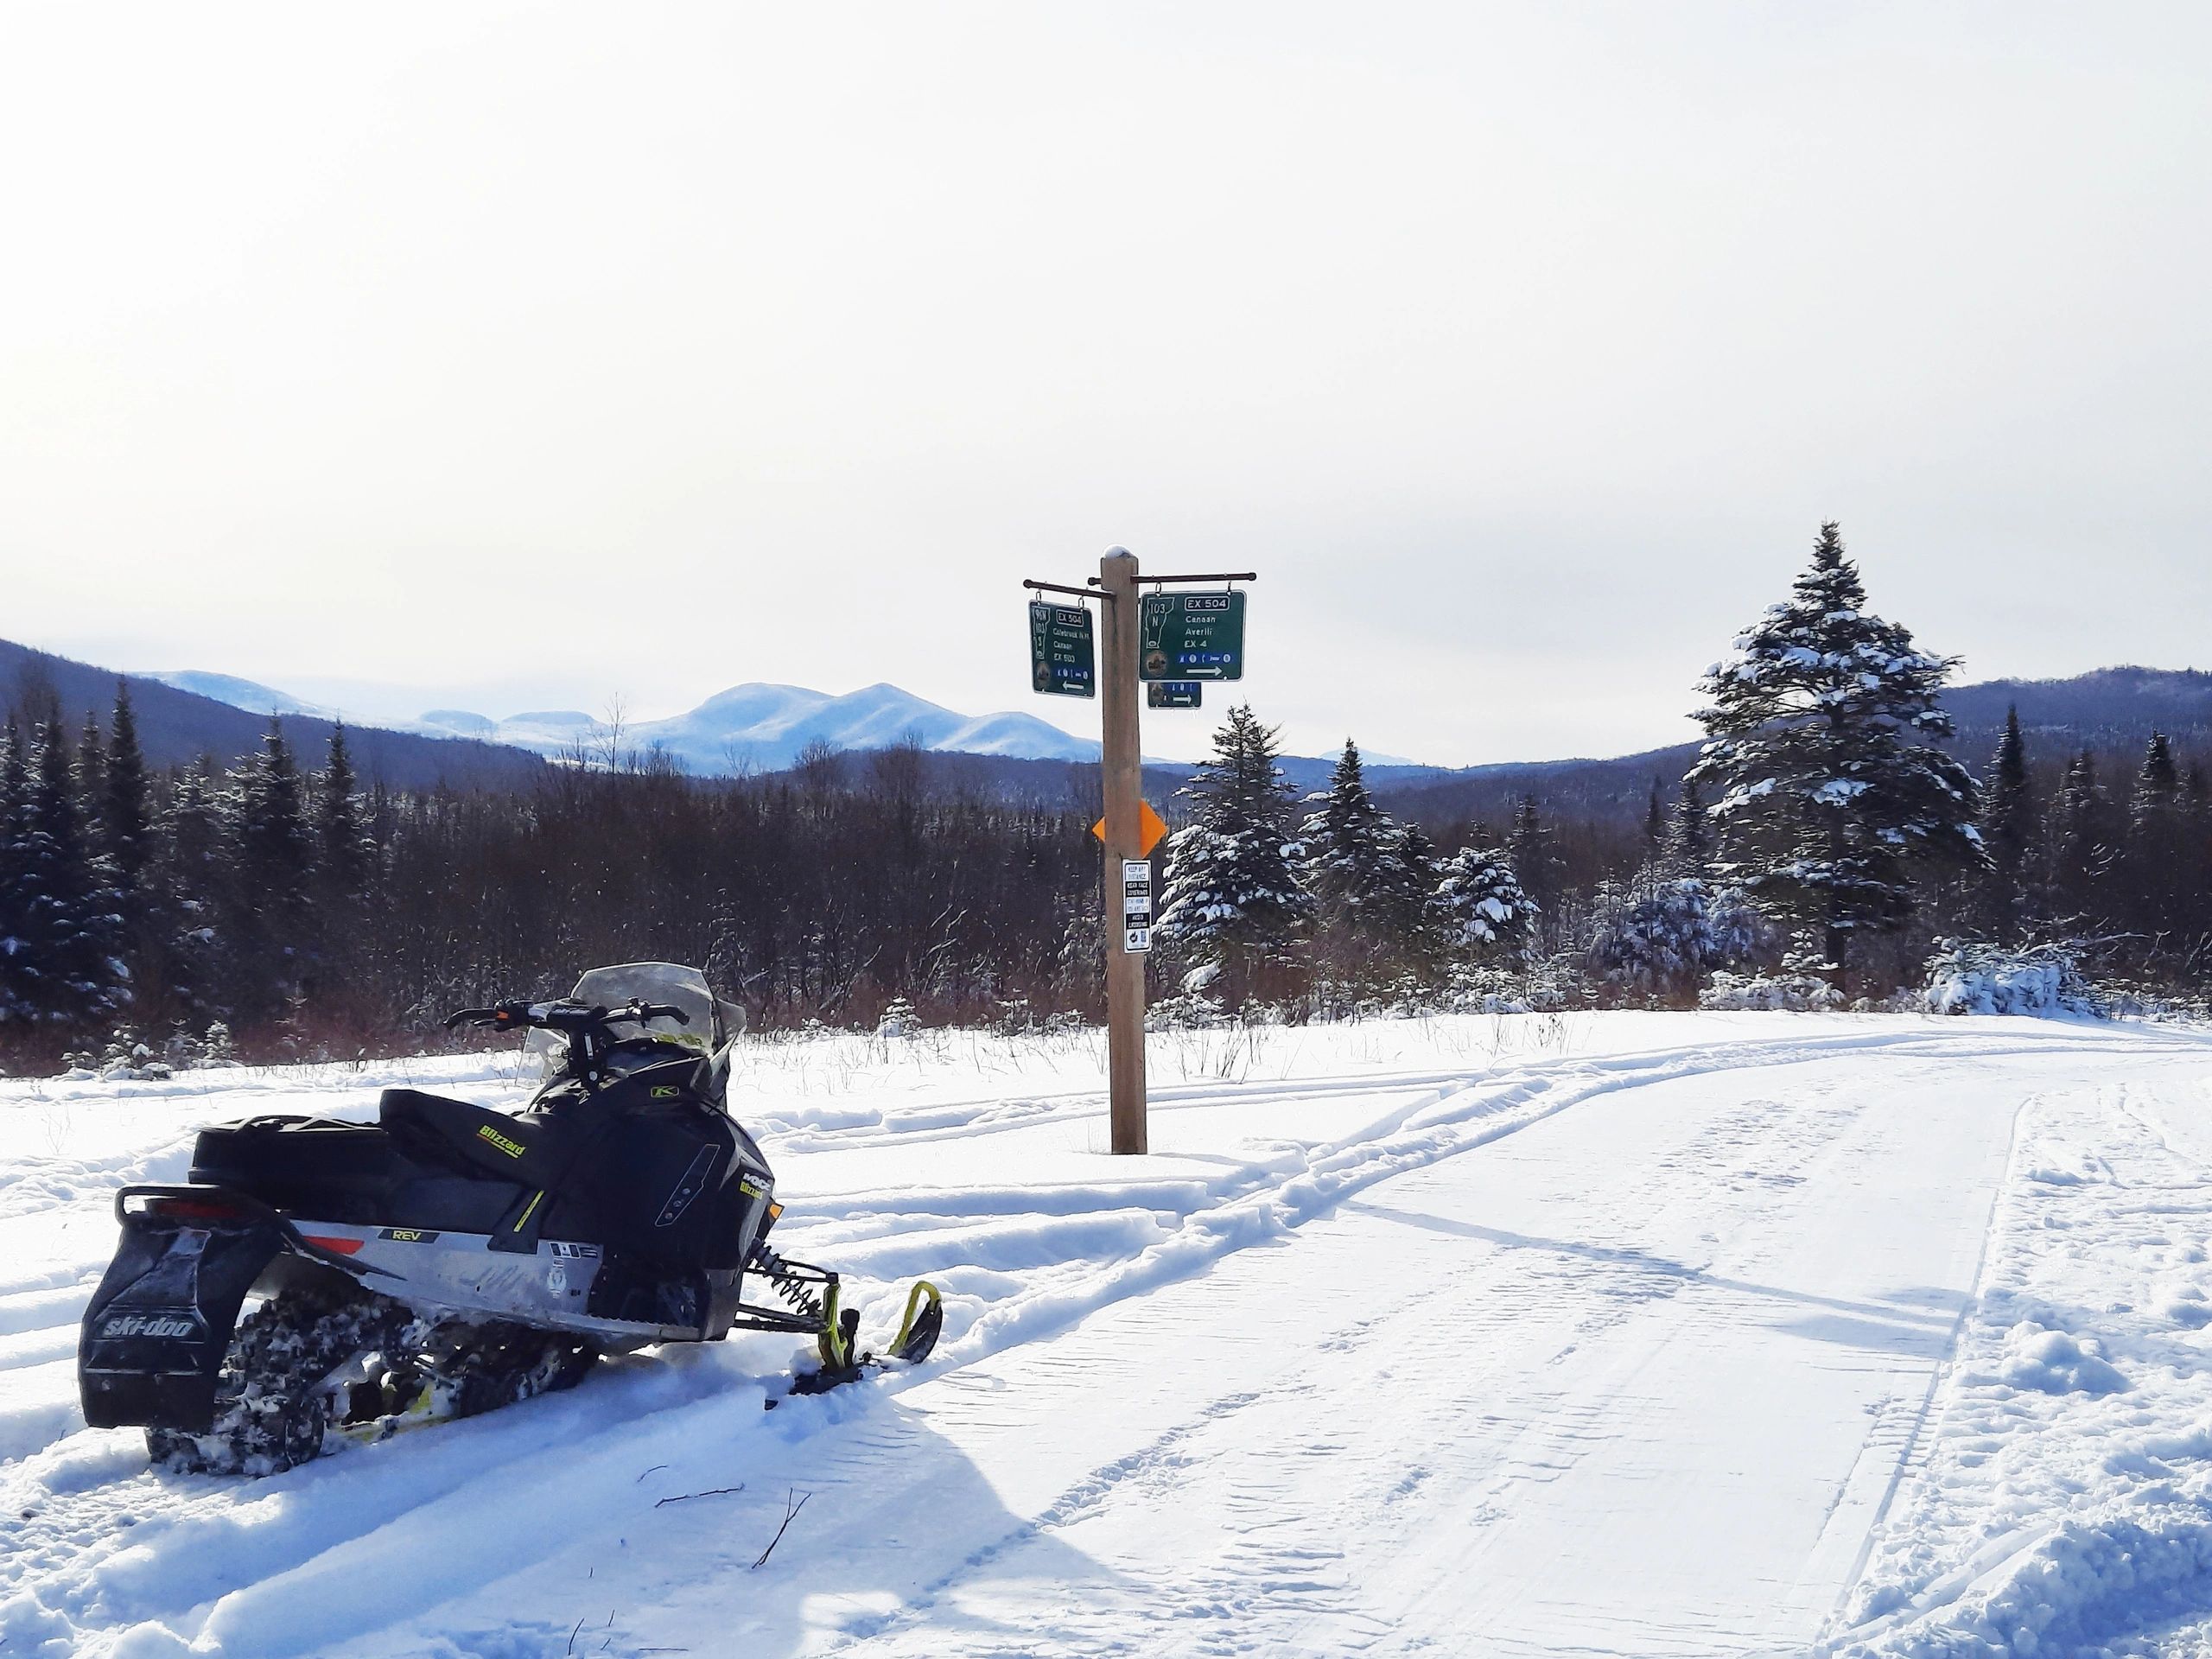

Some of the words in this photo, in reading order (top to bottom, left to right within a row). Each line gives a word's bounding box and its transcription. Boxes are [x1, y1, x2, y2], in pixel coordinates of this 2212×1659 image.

[1150, 603, 1165, 614] 103
[1188, 600, 1201, 608] EX
[1205, 600, 1226, 608] 504
[1058, 613, 1067, 621] EX
[1069, 614, 1082, 624] 504
[479, 1124, 526, 1155] Blizzard
[392, 1230, 421, 1241] REV
